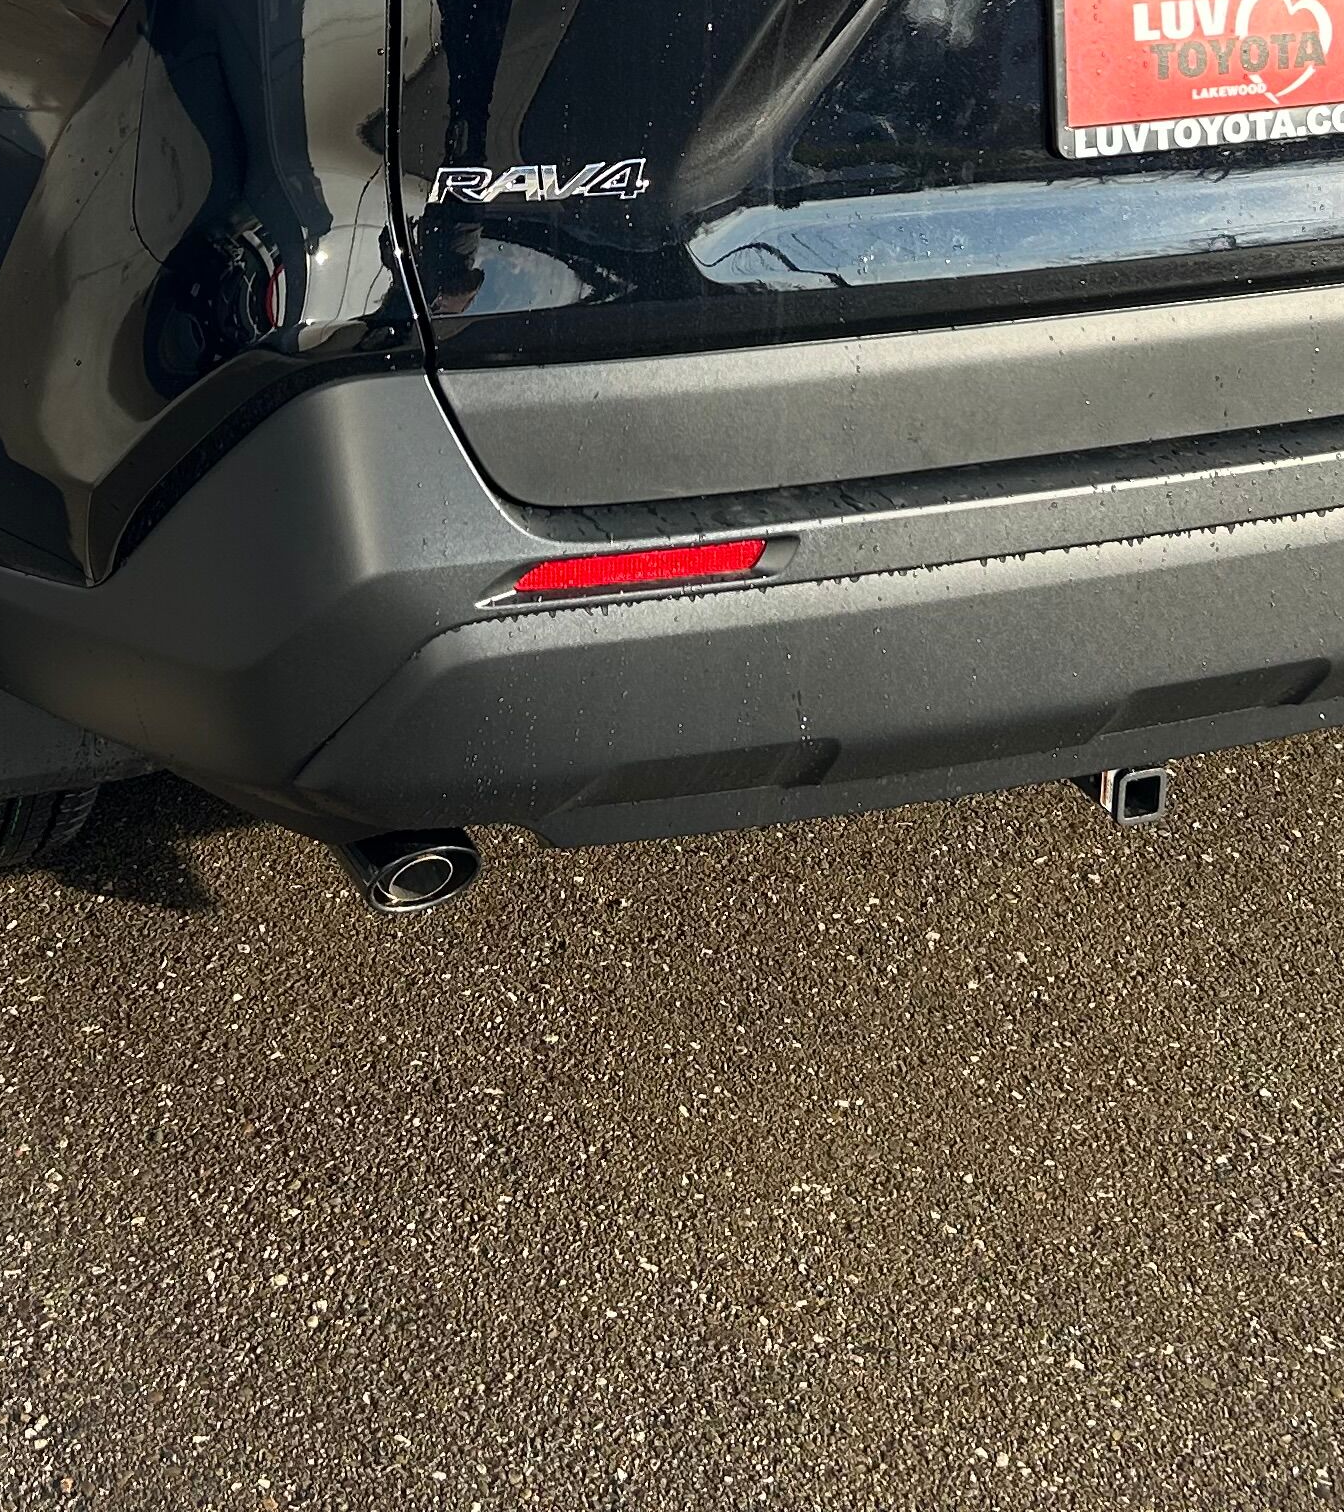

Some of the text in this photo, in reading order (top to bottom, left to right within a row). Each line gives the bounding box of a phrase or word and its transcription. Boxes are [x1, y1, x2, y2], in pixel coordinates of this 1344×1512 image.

[1149, 30, 1327, 80] TOYOTA
[1191, 82, 1268, 100] LAKEWOOD
[426, 157, 650, 204] RAV4
